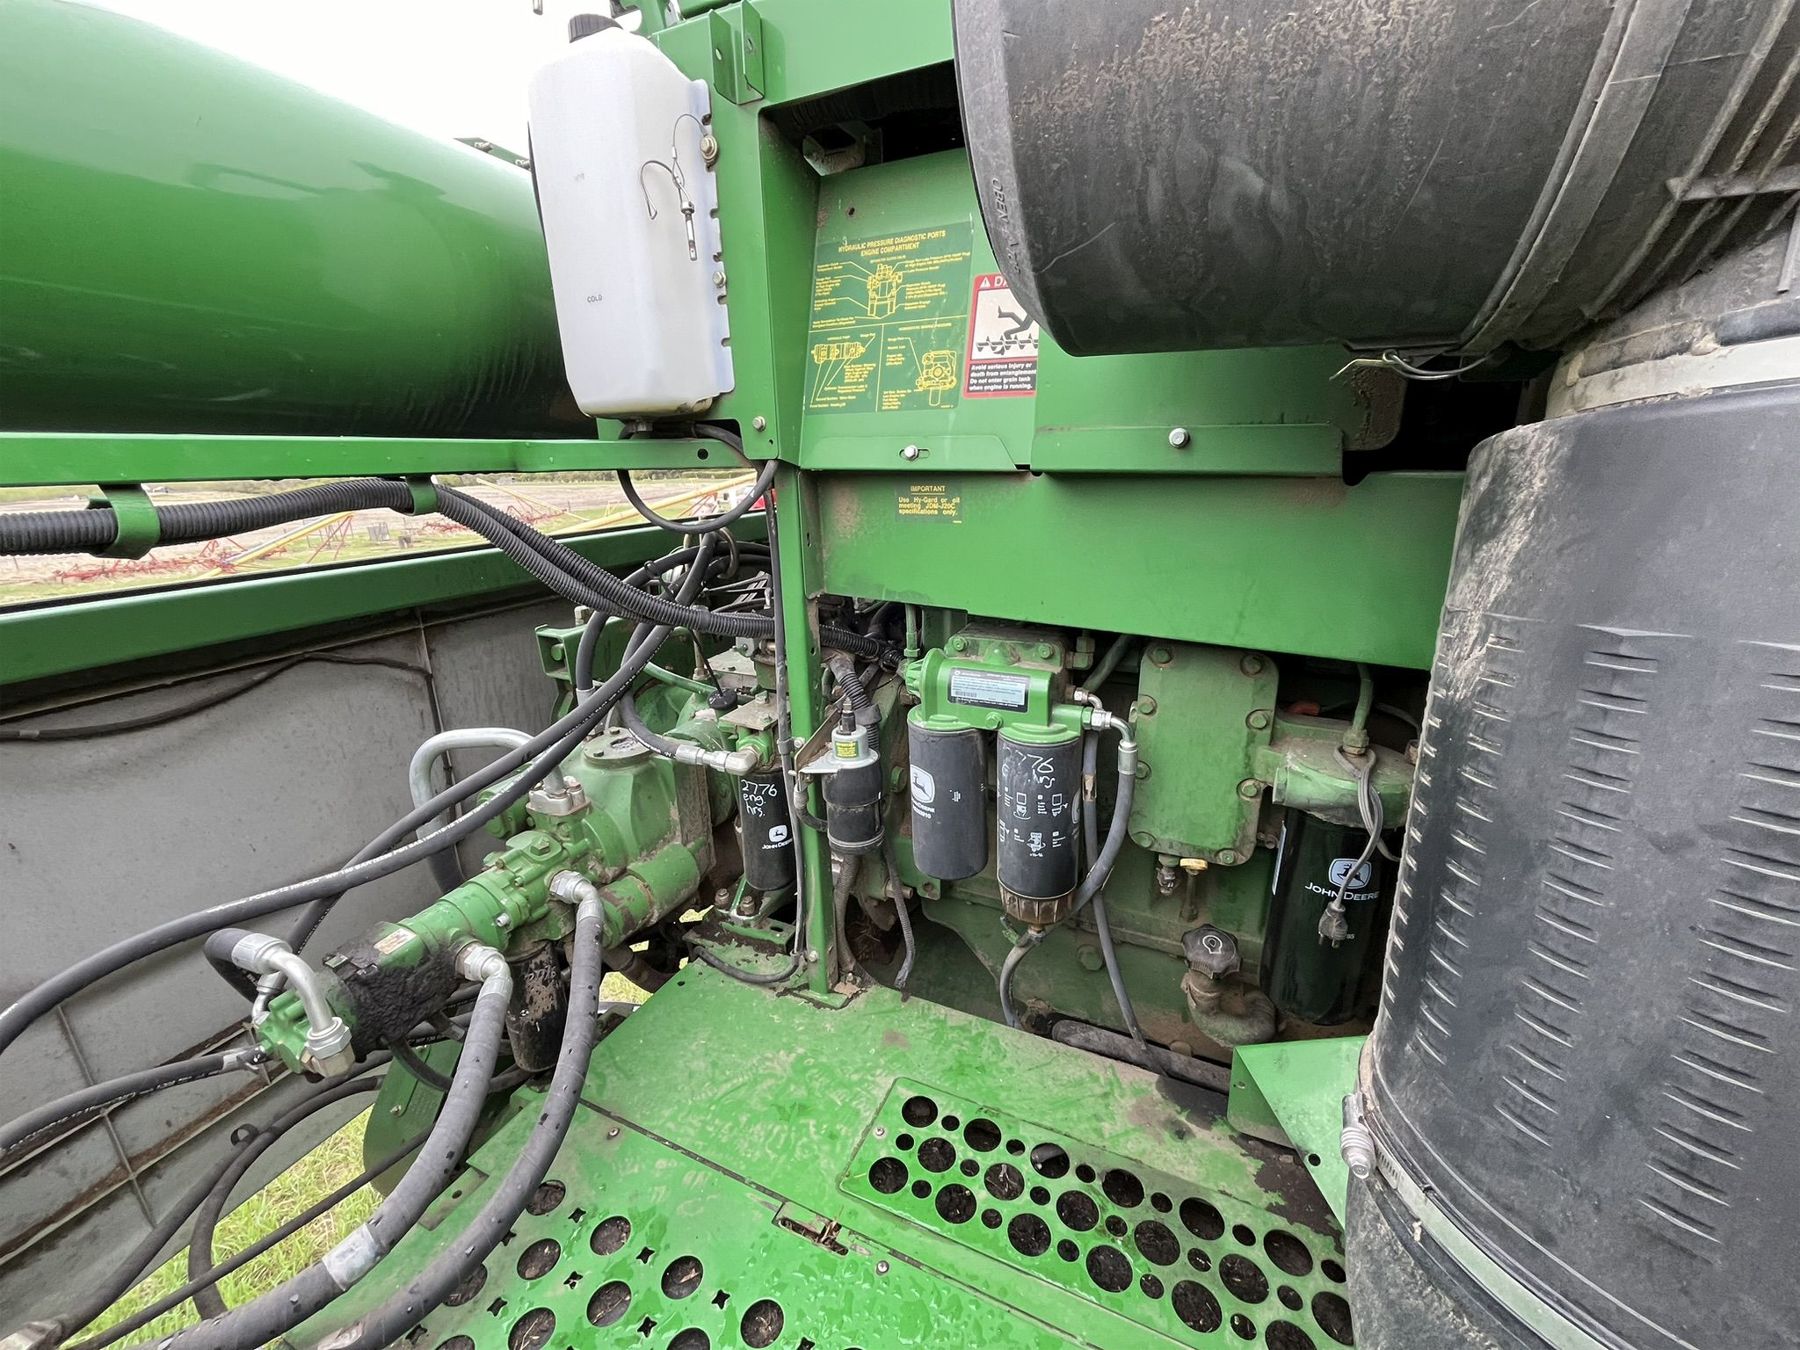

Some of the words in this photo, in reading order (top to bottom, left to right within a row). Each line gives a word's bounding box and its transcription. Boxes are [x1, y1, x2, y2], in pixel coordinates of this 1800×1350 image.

[838, 242, 867, 252] HYDRAULIC
[867, 237, 894, 249] PRESSURE
[894, 233, 927, 245] DIAGNOSTIC
[927, 230, 946, 240] PORTS
[860, 248, 880, 257] ENGINE
[880, 241, 920, 255] COMPARTMENT
[587, 294, 602, 303] COLD
[1003, 376, 1018, 384] grain
[942, 509, 958, 517] only.
[741, 779, 778, 797] 2776
[1304, 882, 1339, 898] JOHN
[1344, 891, 1380, 901] DEERE
